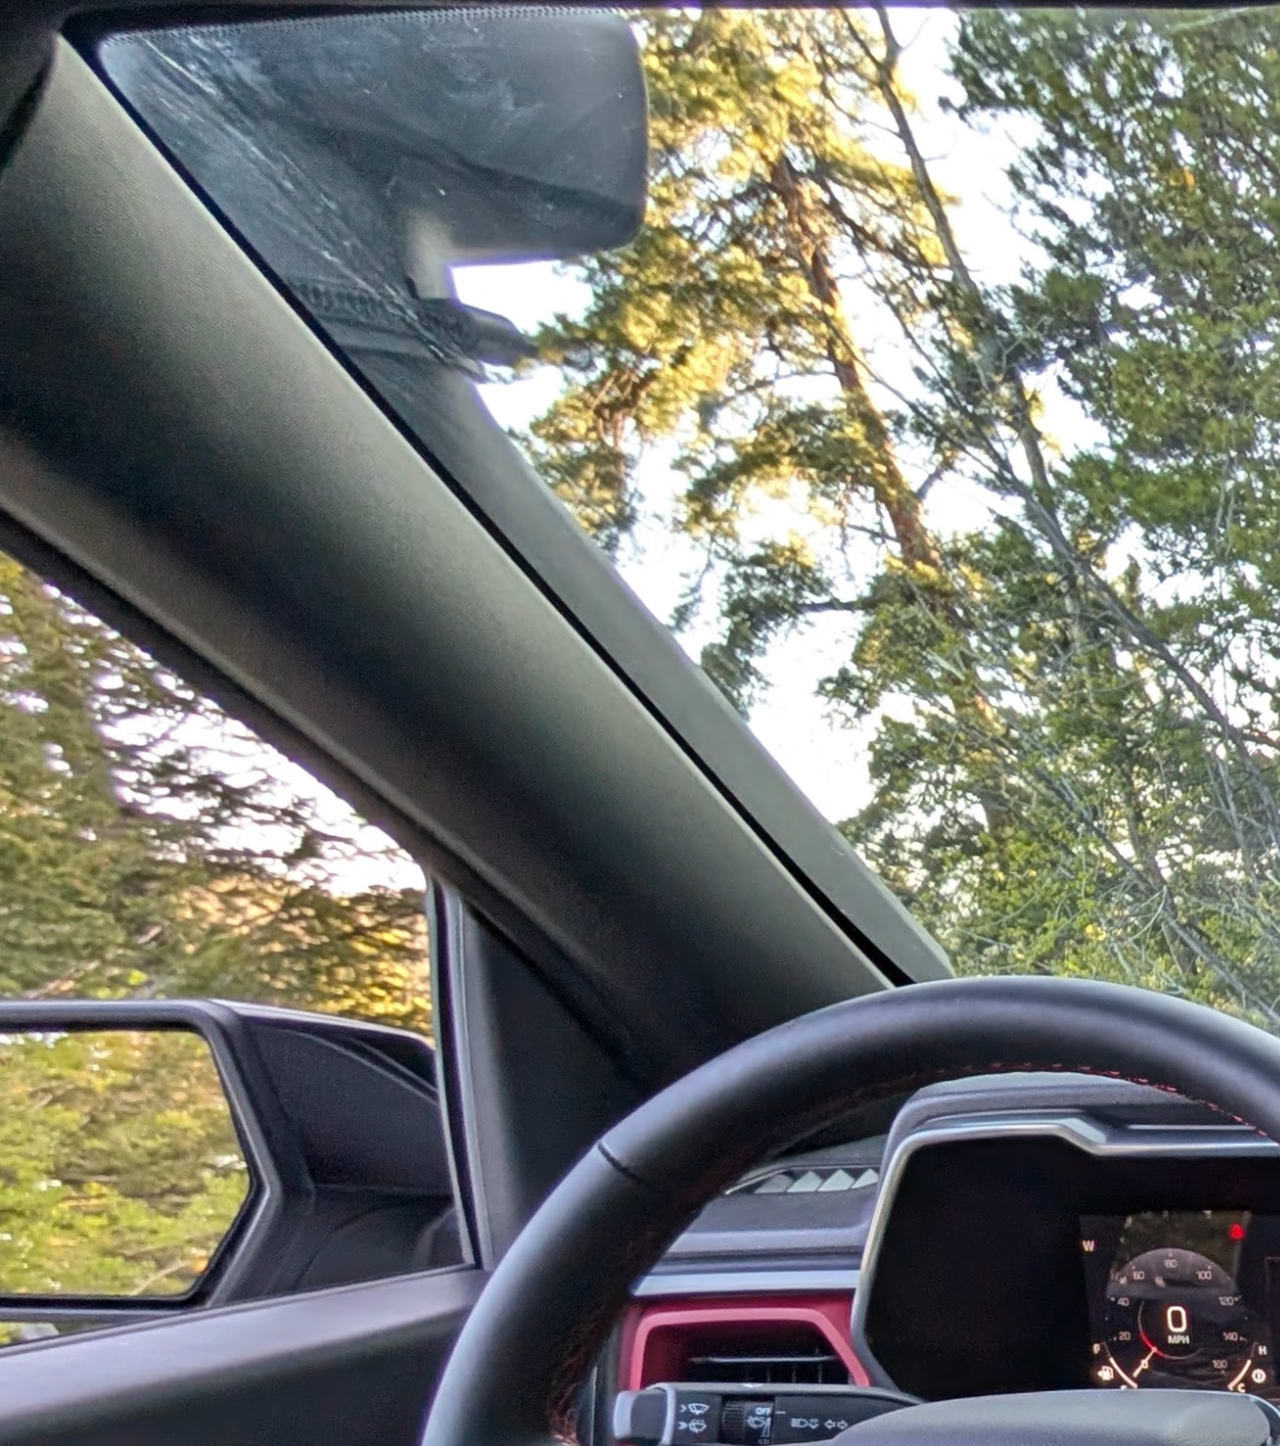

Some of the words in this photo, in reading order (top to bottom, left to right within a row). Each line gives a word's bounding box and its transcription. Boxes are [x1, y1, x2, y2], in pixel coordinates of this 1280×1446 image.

[1082, 1240, 1095, 1251] W
[1163, 1259, 1178, 1268] 80
[1196, 1271, 1213, 1280] 100
[1117, 1298, 1130, 1306] 40
[1166, 1305, 1187, 1333] 0
[1119, 1331, 1131, 1341] 20
[1168, 1335, 1190, 1344] MPH
[1222, 1332, 1238, 1341] 140
[1258, 1345, 1267, 1355] H
[756, 1407, 771, 1415] OFF
